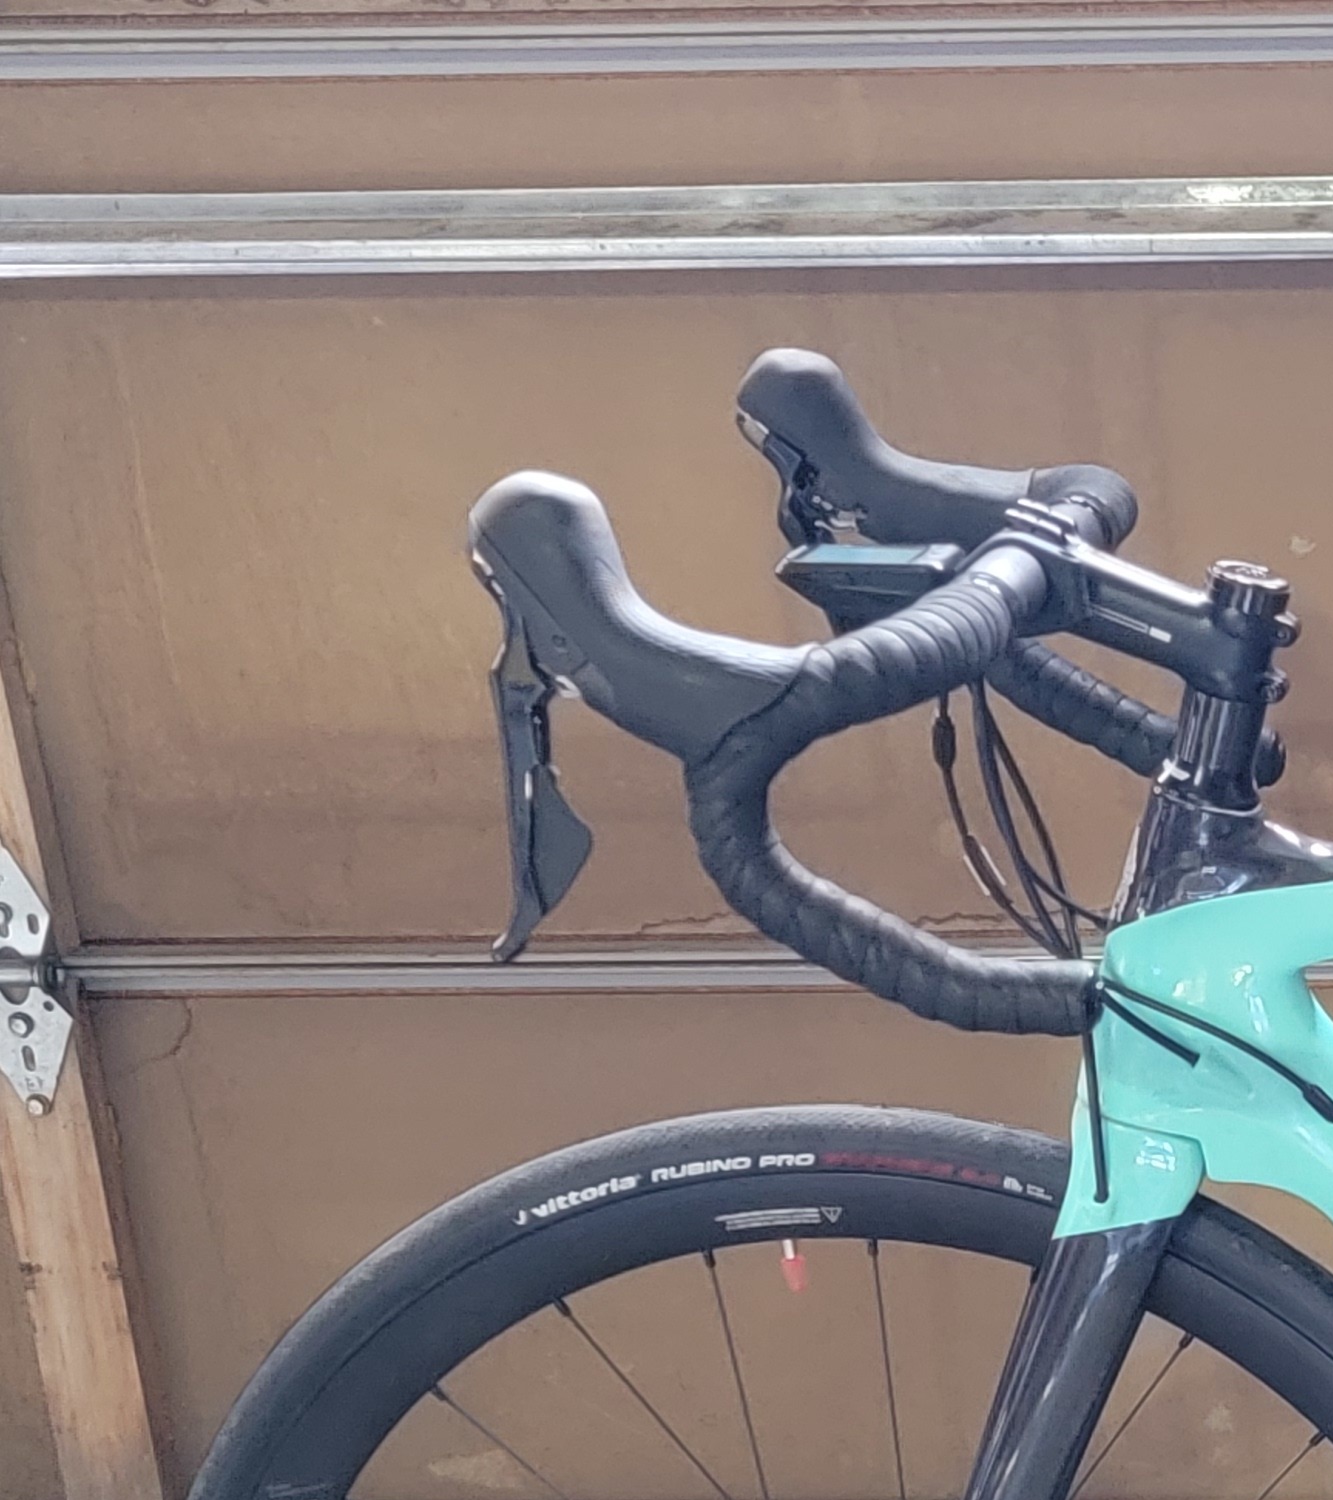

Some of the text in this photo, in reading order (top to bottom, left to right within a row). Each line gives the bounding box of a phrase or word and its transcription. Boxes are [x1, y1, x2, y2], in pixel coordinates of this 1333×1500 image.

[532, 1173, 639, 1218] vittoria
[650, 1154, 752, 1184] RUBINO
[759, 1151, 816, 1170] PRO
